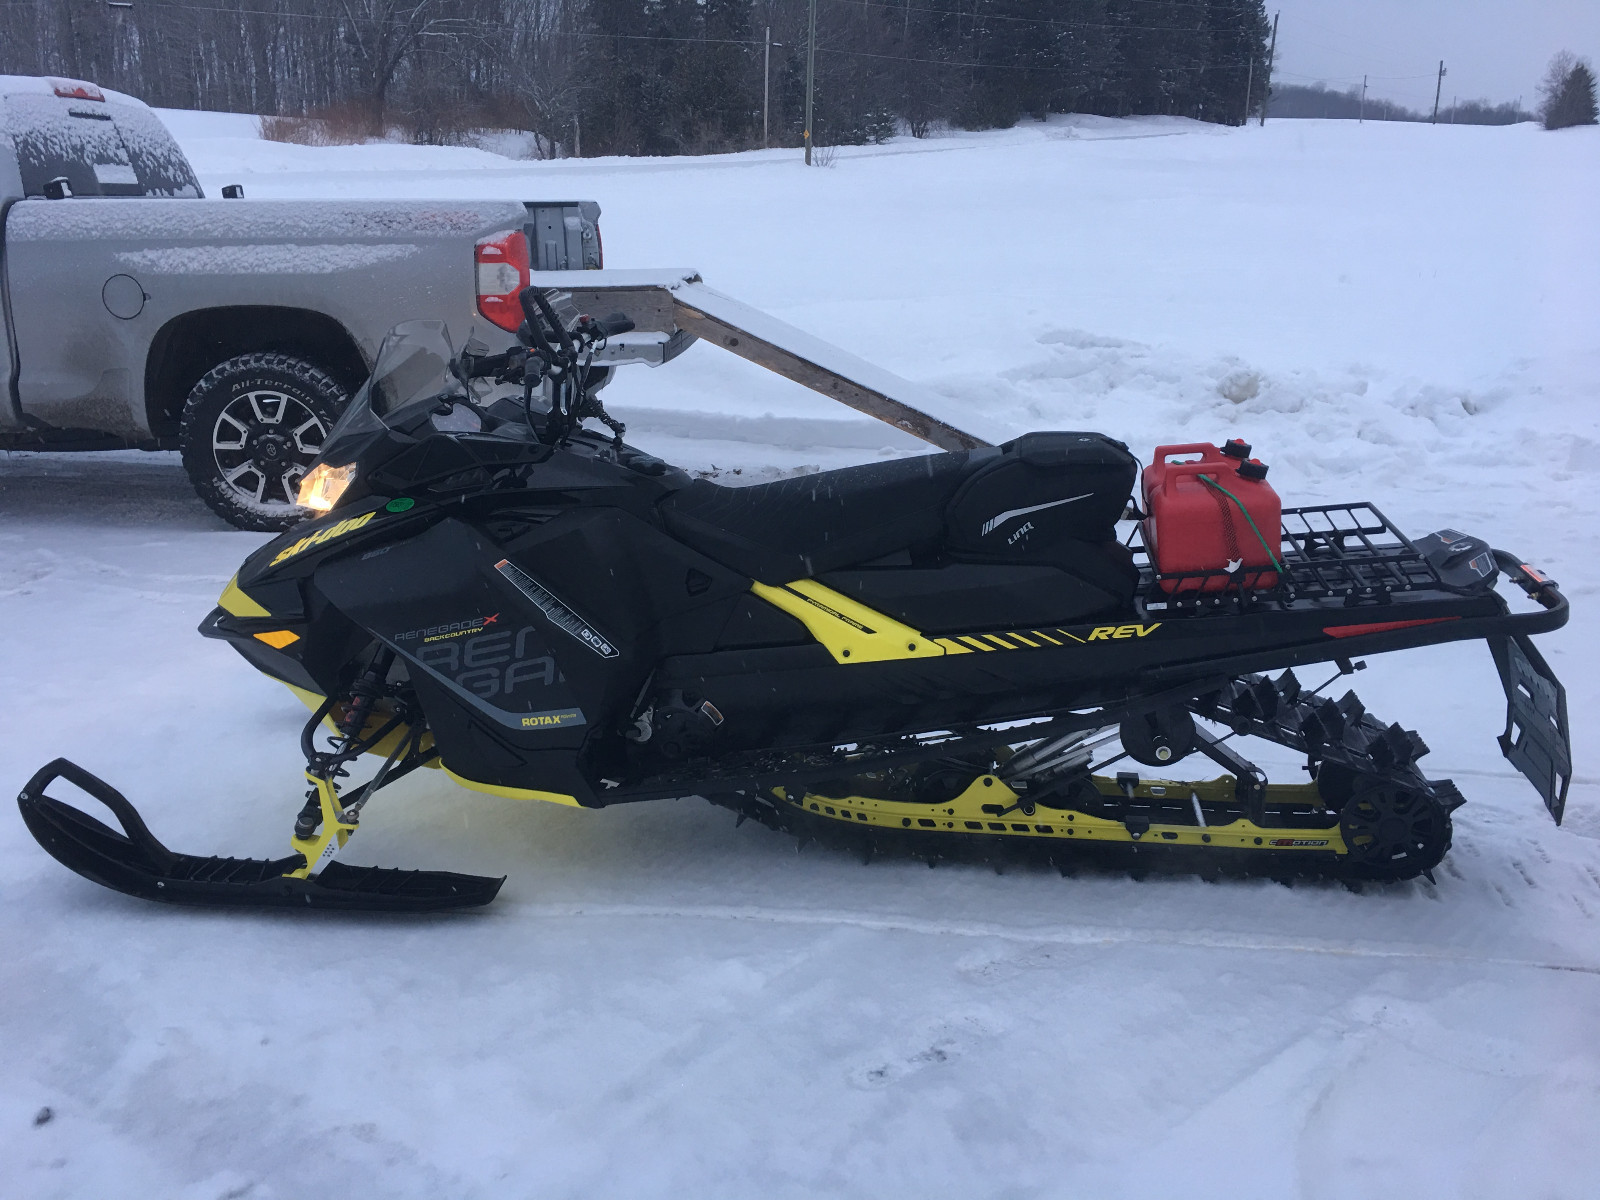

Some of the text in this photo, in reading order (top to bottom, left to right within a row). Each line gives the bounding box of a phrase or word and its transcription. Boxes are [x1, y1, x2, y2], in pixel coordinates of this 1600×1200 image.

[231, 378, 314, 404] All-Terrain
[423, 626, 484, 643] BACKCOUNTRY
[1087, 622, 1163, 641] REV
[521, 715, 561, 727] ROTAX
